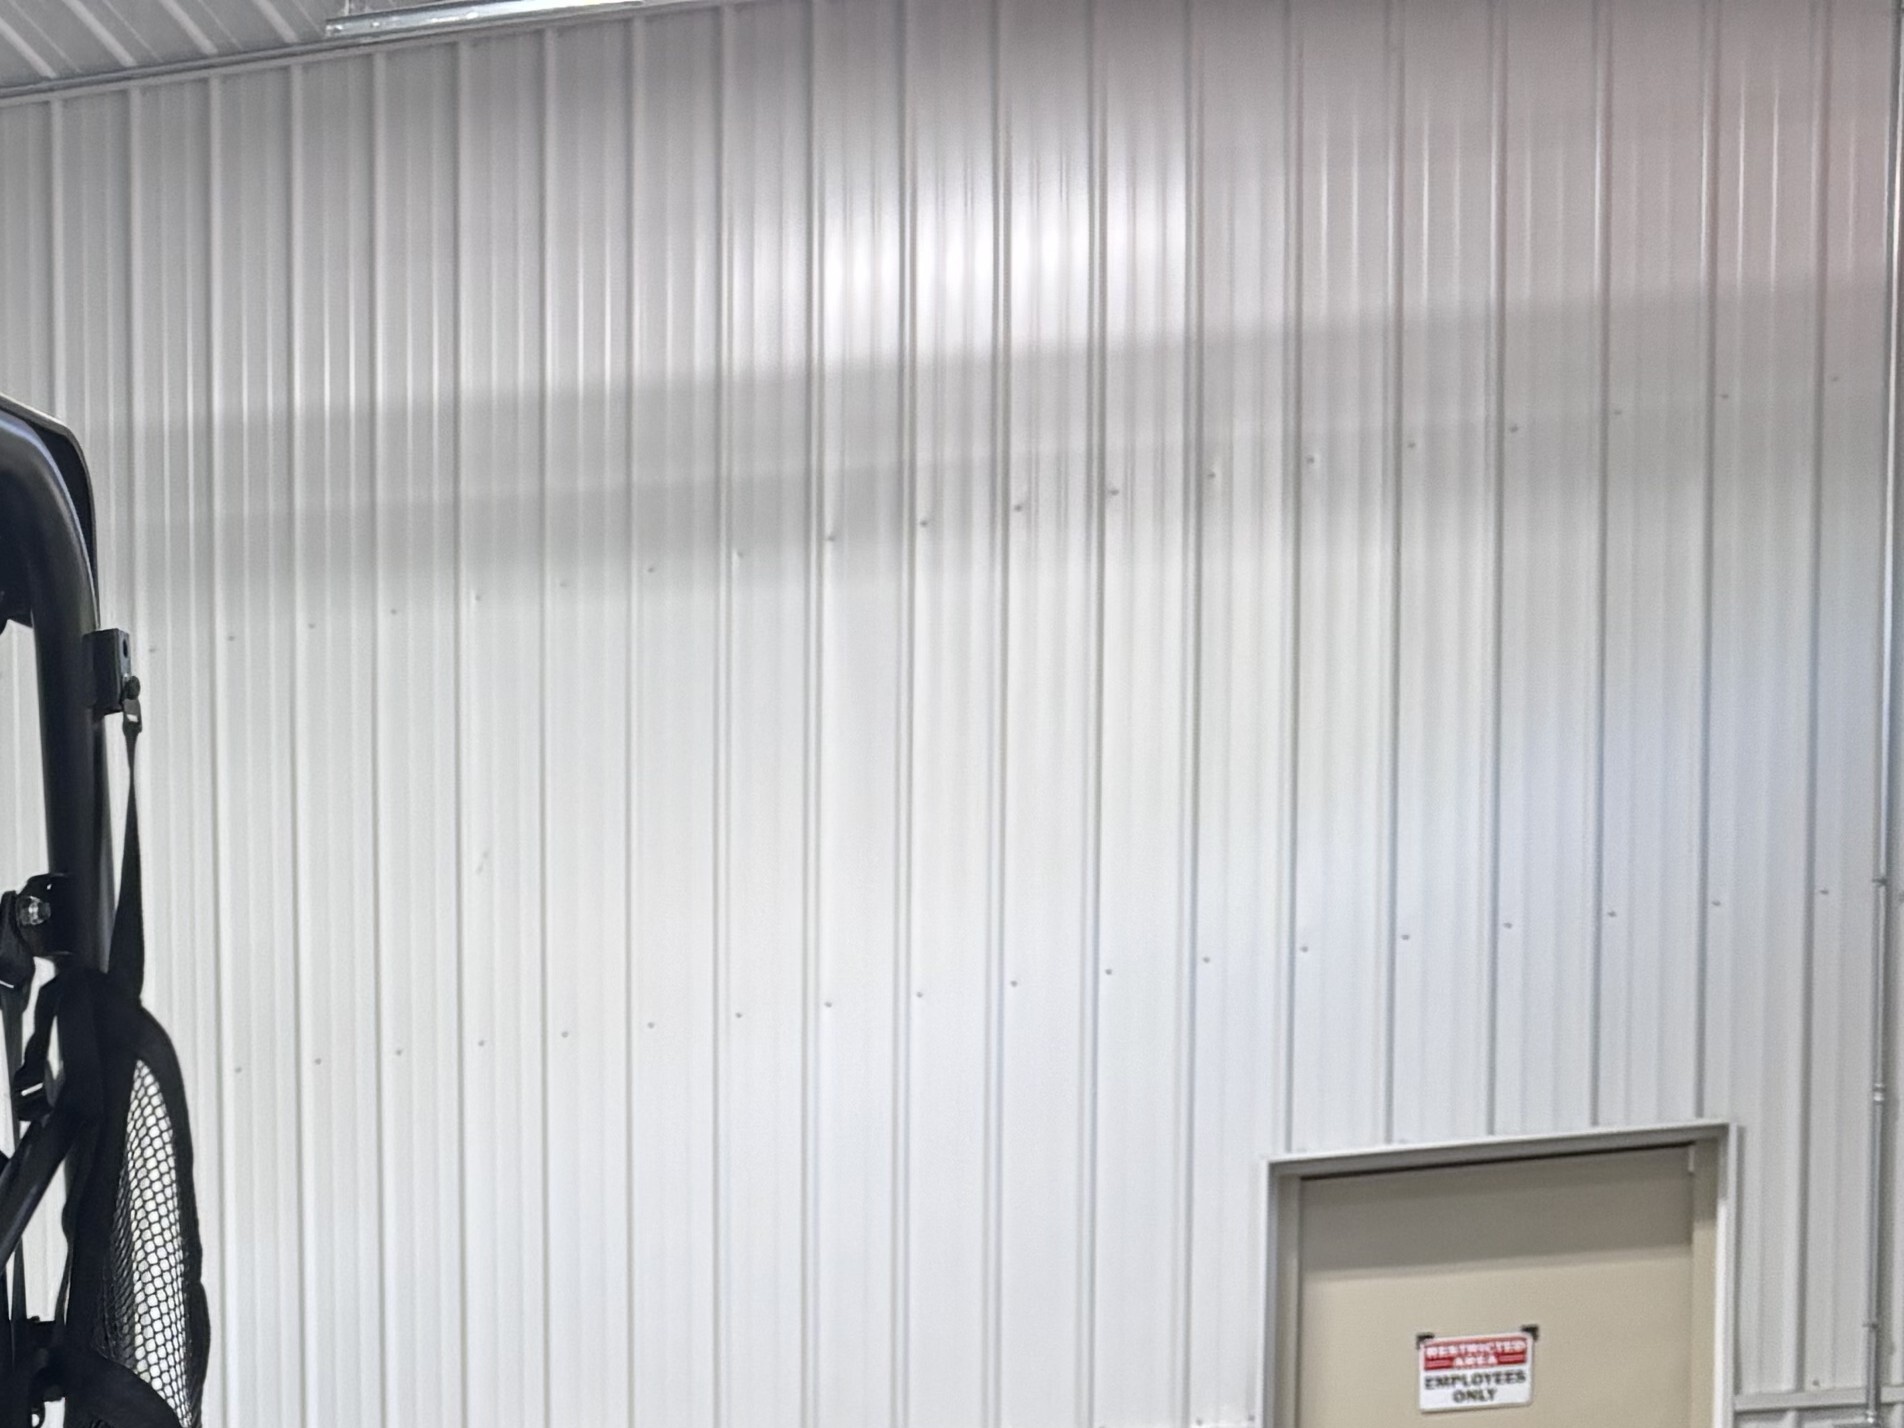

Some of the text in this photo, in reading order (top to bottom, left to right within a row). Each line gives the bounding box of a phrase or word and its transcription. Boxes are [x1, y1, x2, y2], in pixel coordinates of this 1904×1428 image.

[1426, 1340, 1526, 1358] RESTRICTED
[1453, 1355, 1498, 1367] AREA
[1424, 1370, 1526, 1389] EMPLOYEES
[1453, 1388, 1498, 1403] ONLY
